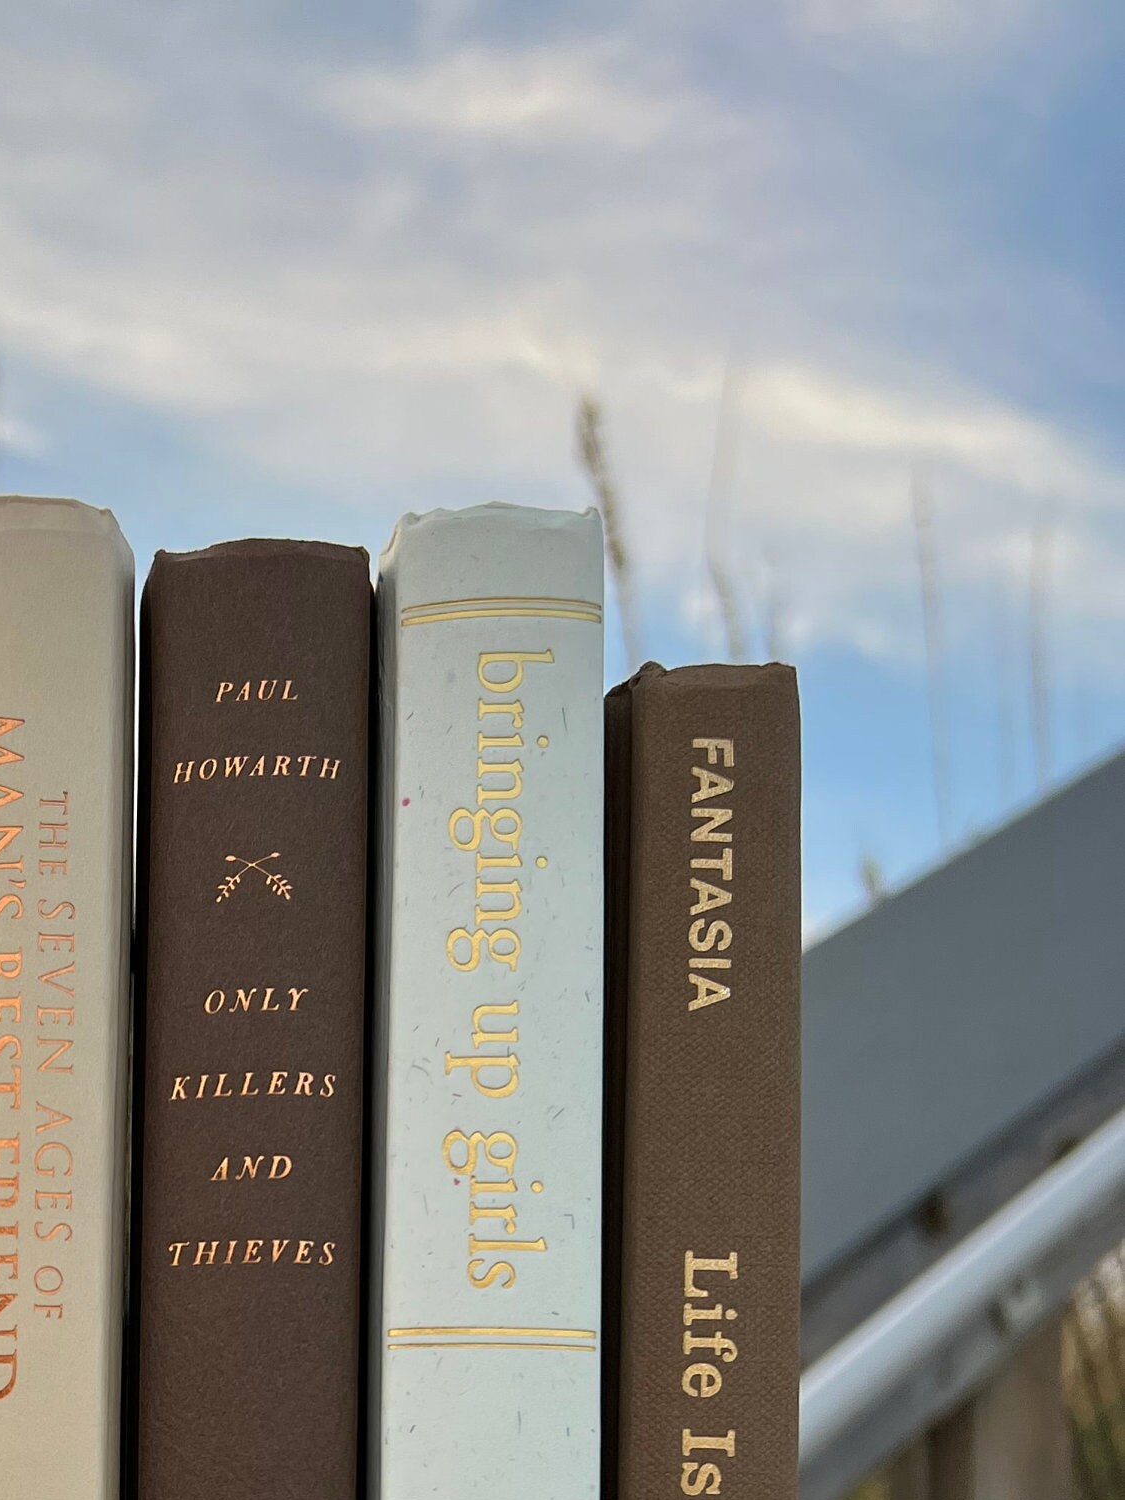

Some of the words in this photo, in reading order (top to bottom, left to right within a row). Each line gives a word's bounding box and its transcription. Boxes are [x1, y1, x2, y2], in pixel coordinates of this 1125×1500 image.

[215, 680, 299, 705] PAUL
[172, 756, 343, 785] HOWARTH
[38, 791, 69, 877] THE
[446, 648, 555, 973] bringing
[686, 736, 736, 1012] FANTASIA
[36, 897, 76, 1076] SEVEN
[203, 987, 308, 1014] ONLY
[169, 1071, 338, 1102] KILLERS
[445, 1000, 520, 1099] up
[35, 1102, 75, 1244] AGES
[211, 1154, 294, 1182] AND
[442, 1128, 547, 1292] girls
[168, 1239, 337, 1269] THIEVES
[33, 1265, 66, 1322] OF
[681, 1249, 740, 1400] Life
[680, 1429, 736, 1496] Is
